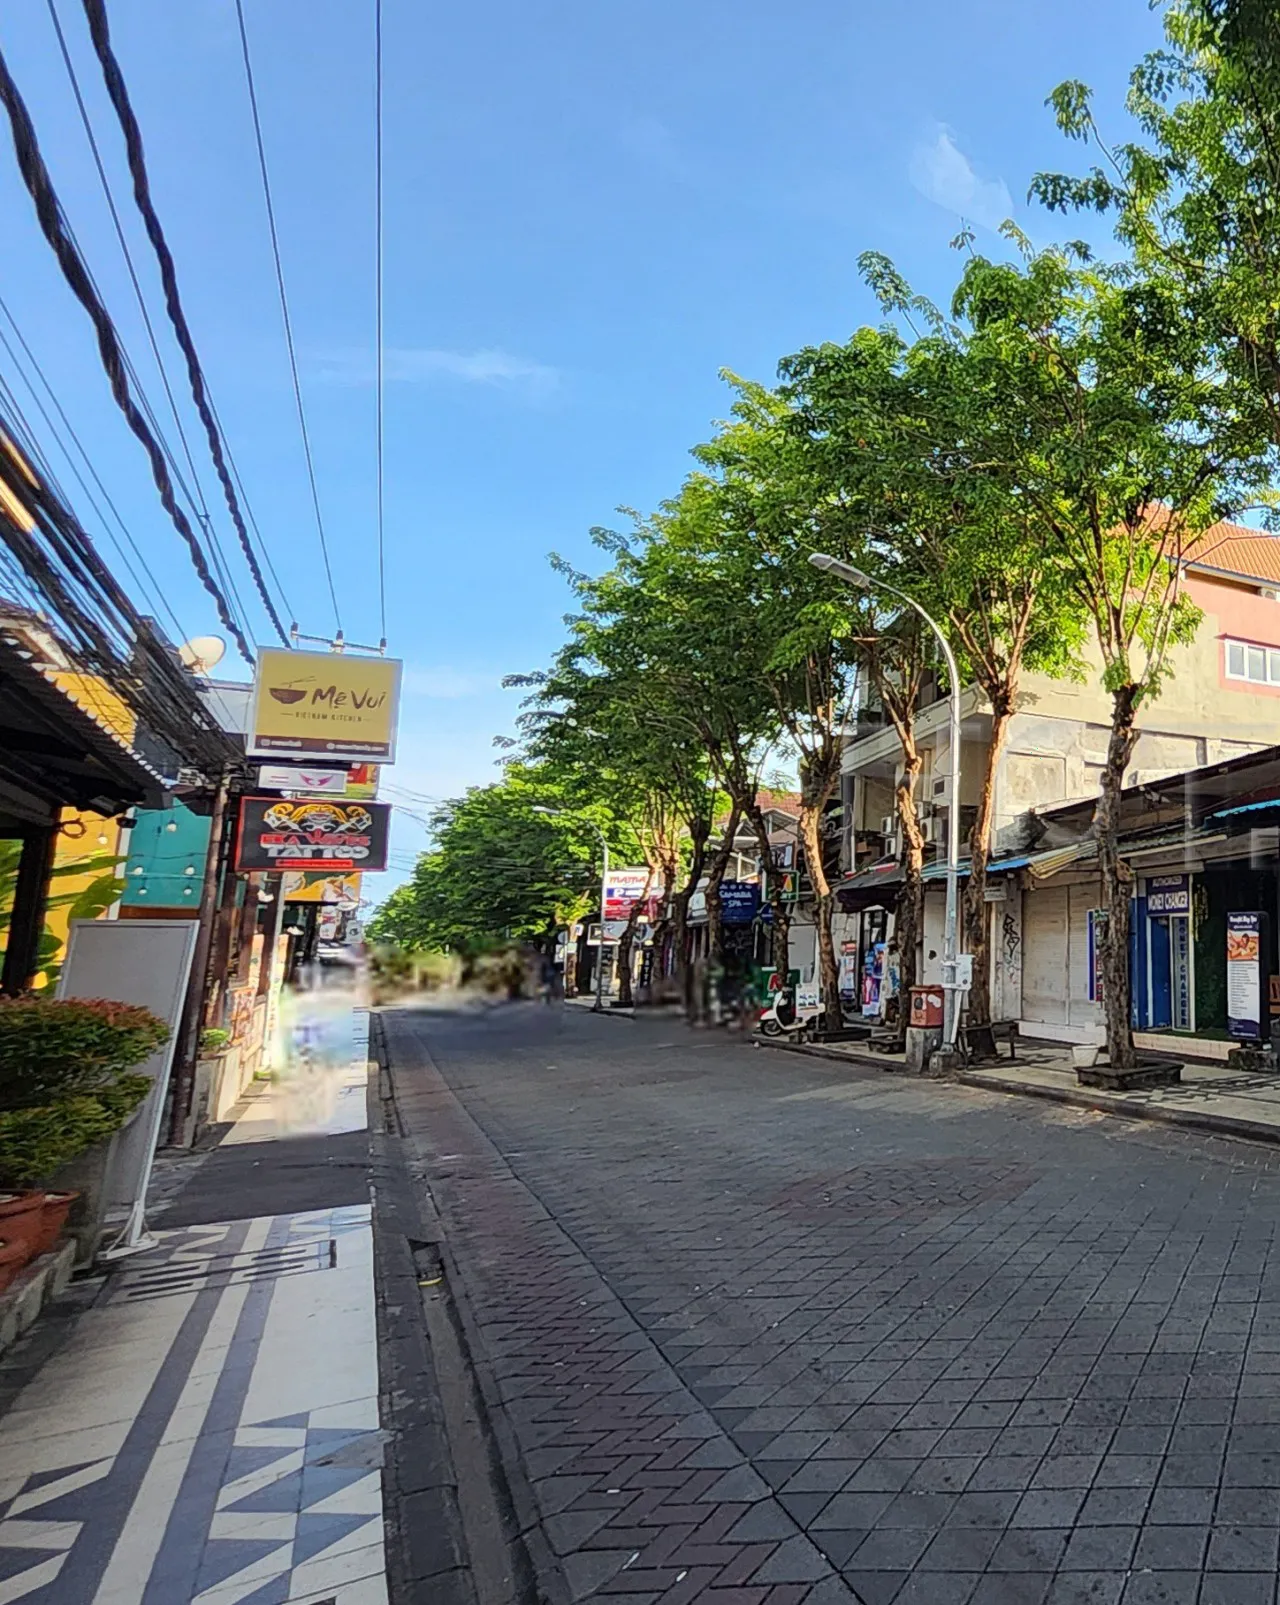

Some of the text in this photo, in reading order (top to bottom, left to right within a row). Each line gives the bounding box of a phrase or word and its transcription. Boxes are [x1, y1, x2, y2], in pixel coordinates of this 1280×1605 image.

[260, 843, 370, 860] TATTOO
[1148, 893, 1165, 911] MONEY
[1178, 918, 1188, 1025] MONEY CHANGER
